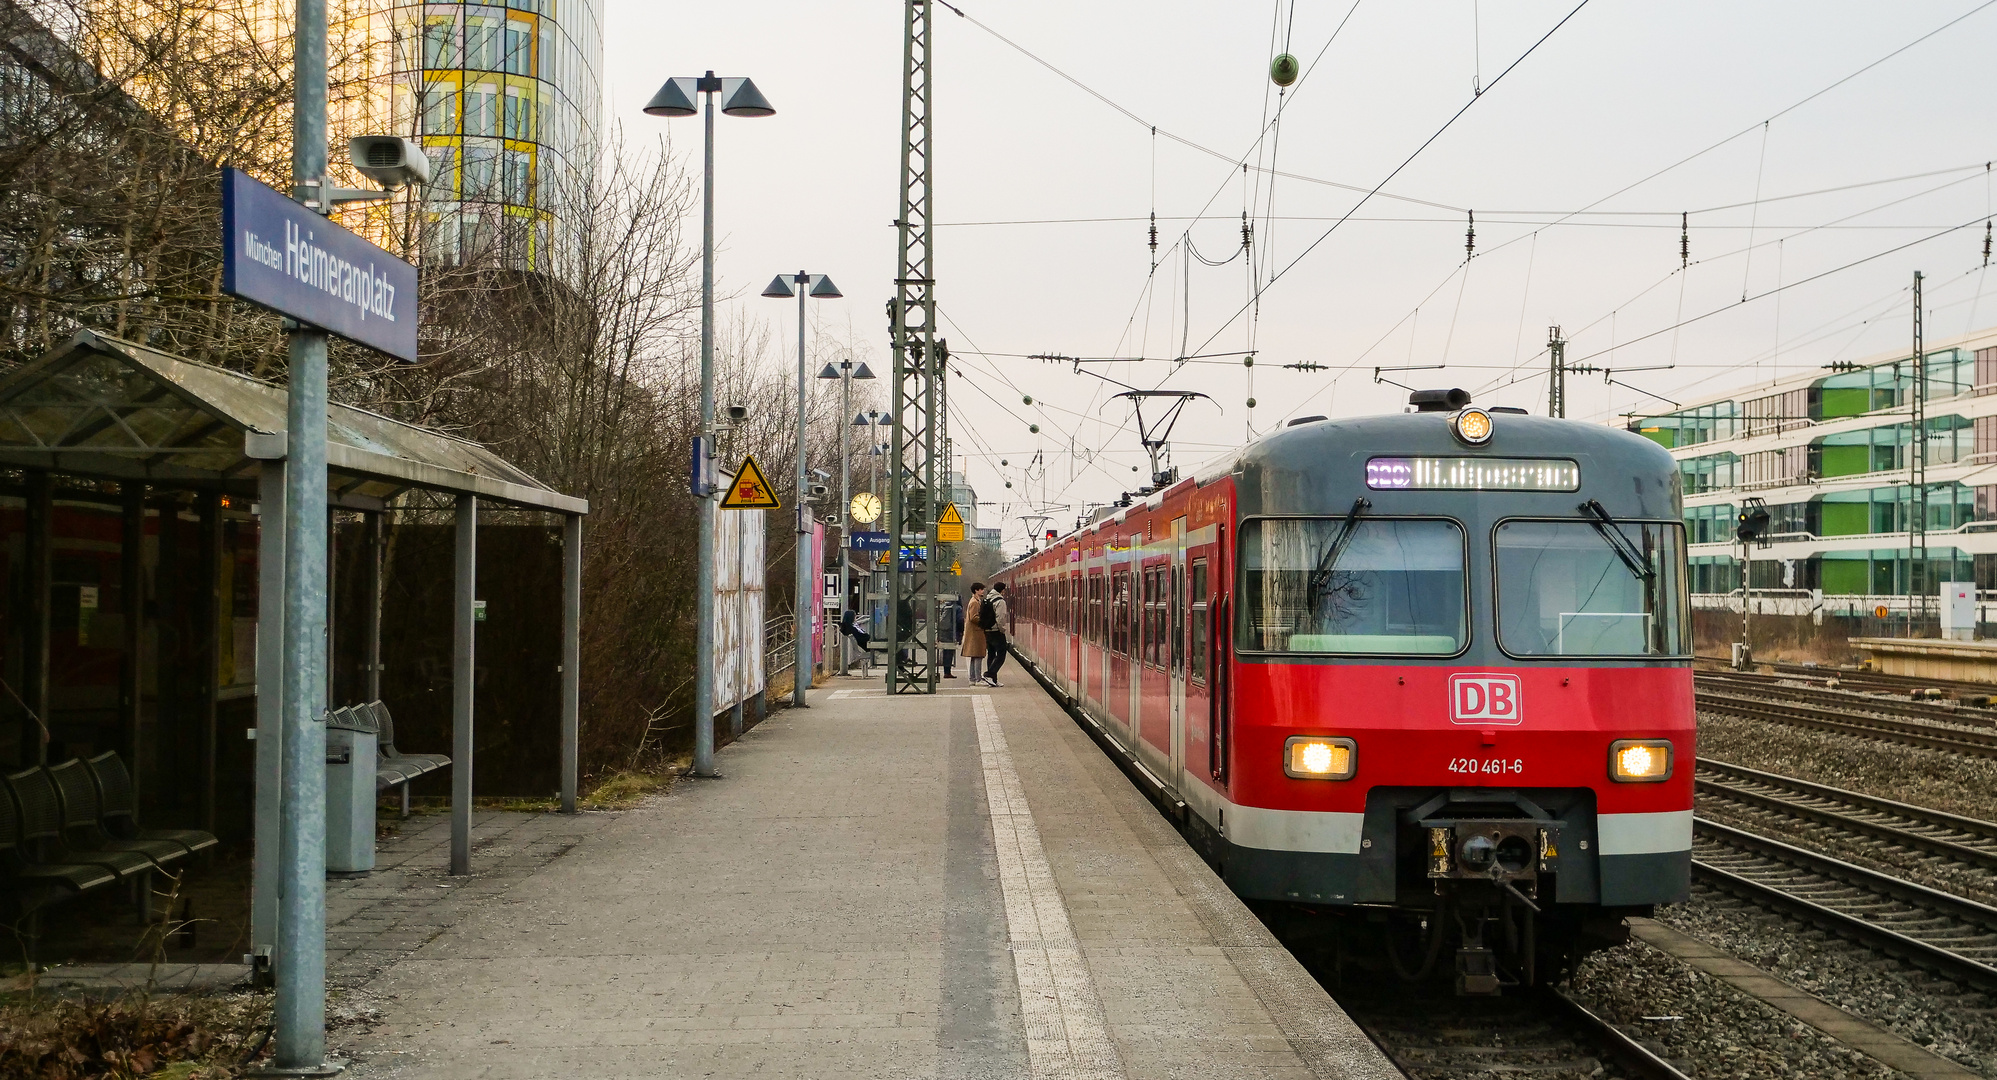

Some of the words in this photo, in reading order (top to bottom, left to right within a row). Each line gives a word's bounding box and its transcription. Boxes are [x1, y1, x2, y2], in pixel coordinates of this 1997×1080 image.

[245, 231, 283, 272] München
[285, 219, 395, 322] Heimeranplatz
[1457, 680, 1515, 718] DB
[1448, 757, 1478, 774] 420
[1481, 758, 1523, 775] 461-6
